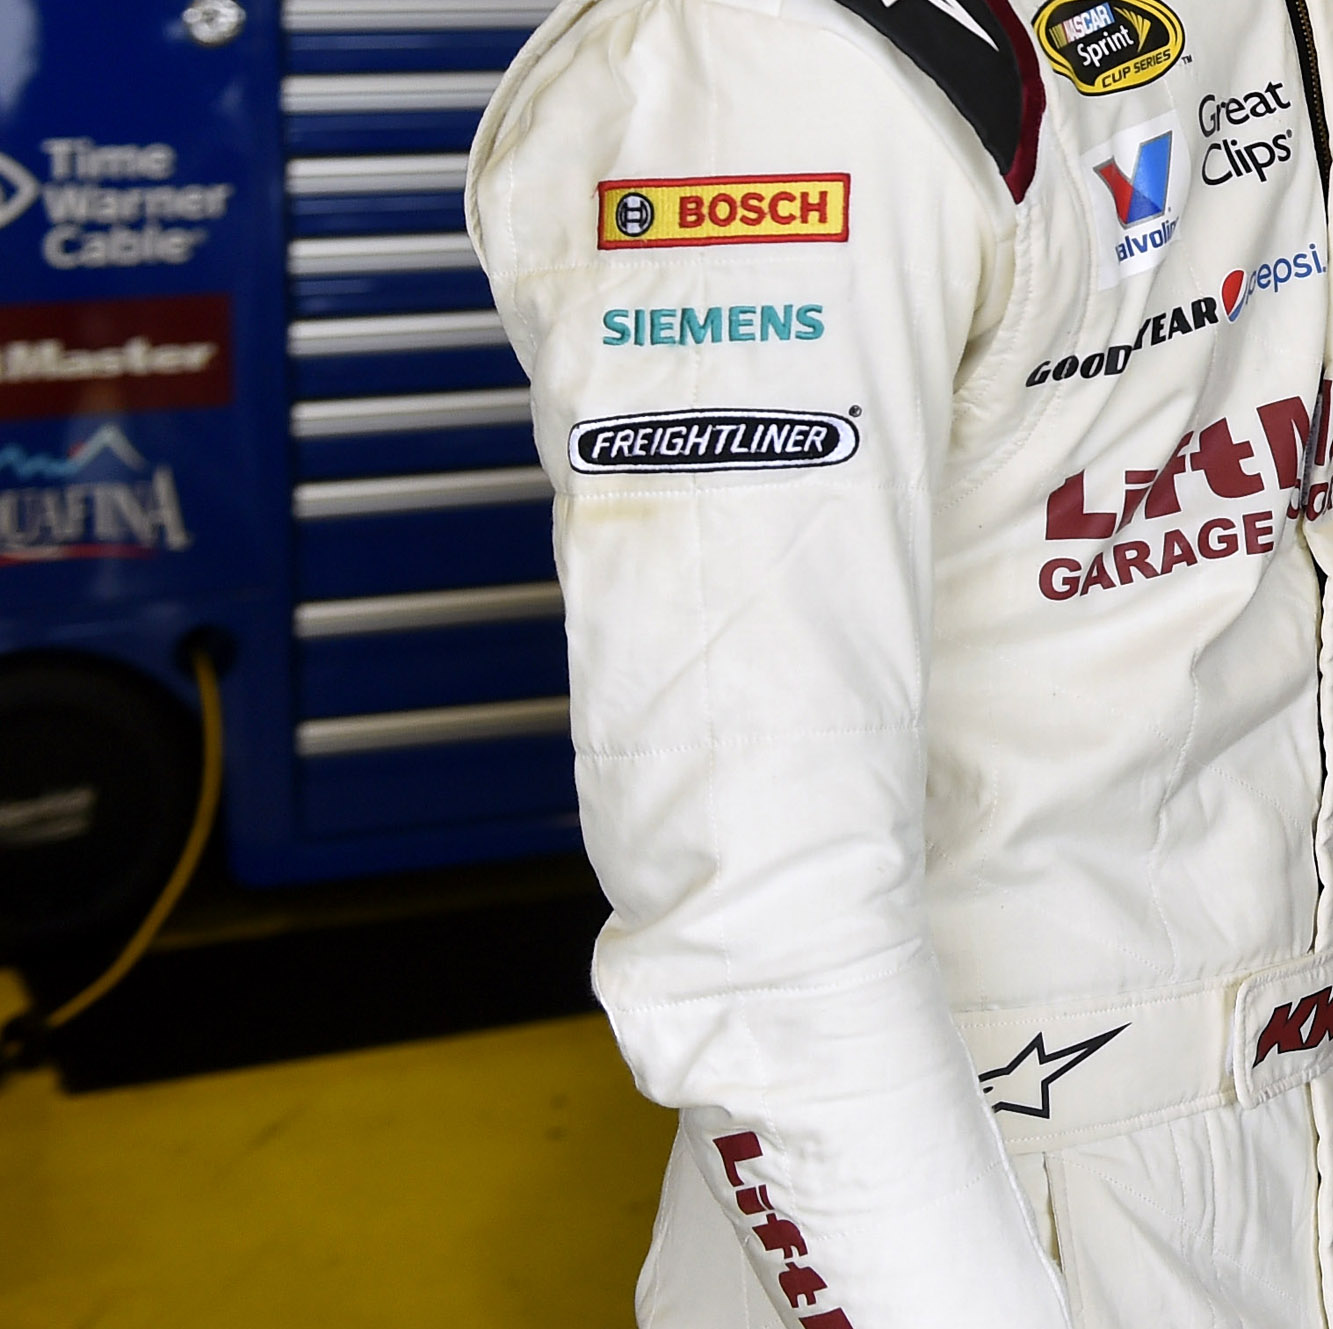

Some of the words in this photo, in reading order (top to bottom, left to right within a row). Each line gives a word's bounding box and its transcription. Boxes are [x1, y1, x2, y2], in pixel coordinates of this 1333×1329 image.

[1064, 3, 1112, 42] NASCAR
[1077, 24, 1135, 67] Sprint
[1101, 67, 1132, 88] CUP
[1133, 48, 1171, 74] SERIES
[1199, 81, 1291, 138] Great
[41, 136, 177, 180] Time
[1201, 136, 1292, 186] Clips
[43, 183, 235, 224] Warner
[678, 190, 829, 229] BOSCH
[42, 222, 199, 270] Cable
[1246, 243, 1323, 305] pepsi
[602, 305, 825, 346] SIEMENS
[591, 423, 828, 459] FREIGHTLINER
[1038, 510, 1275, 602] GARAGE
